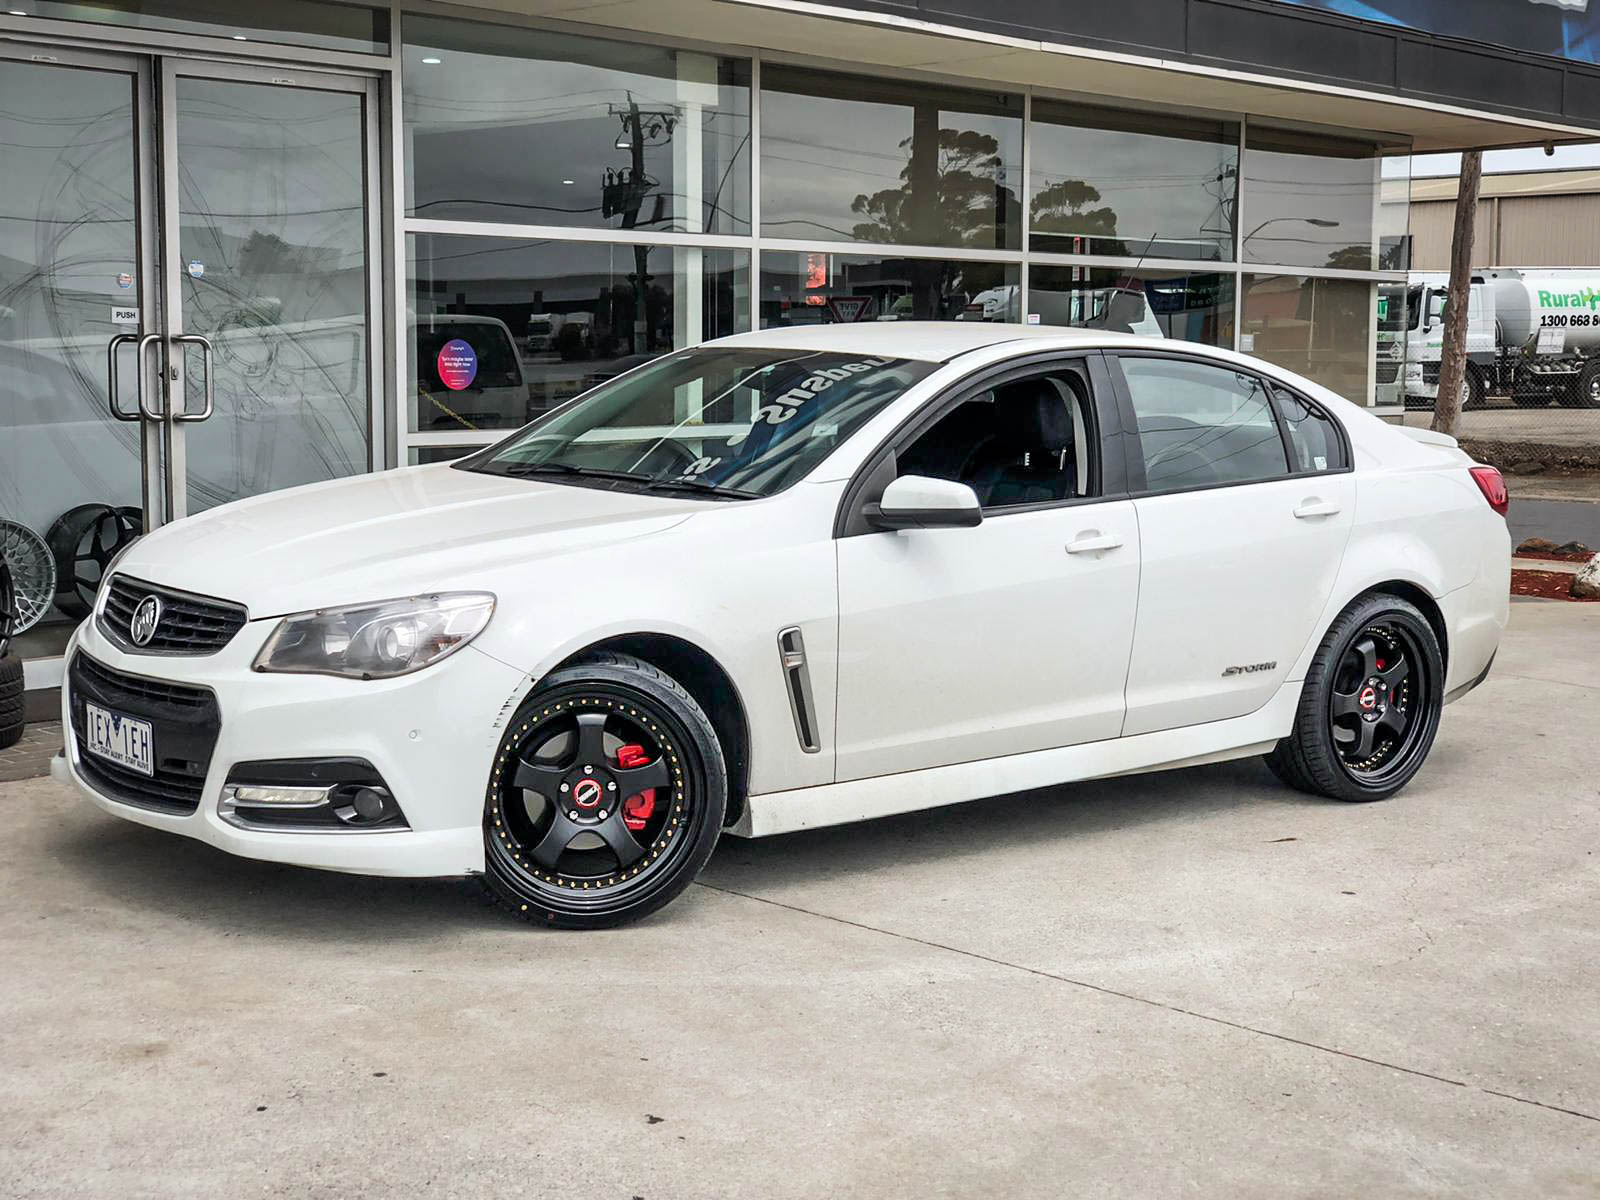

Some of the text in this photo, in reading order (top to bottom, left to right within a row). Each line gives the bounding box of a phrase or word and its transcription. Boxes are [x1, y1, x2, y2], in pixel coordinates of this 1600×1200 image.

[115, 311, 137, 319] PUSH
[1540, 314, 1568, 327] 1300
[1591, 314, 1600, 327] 8
